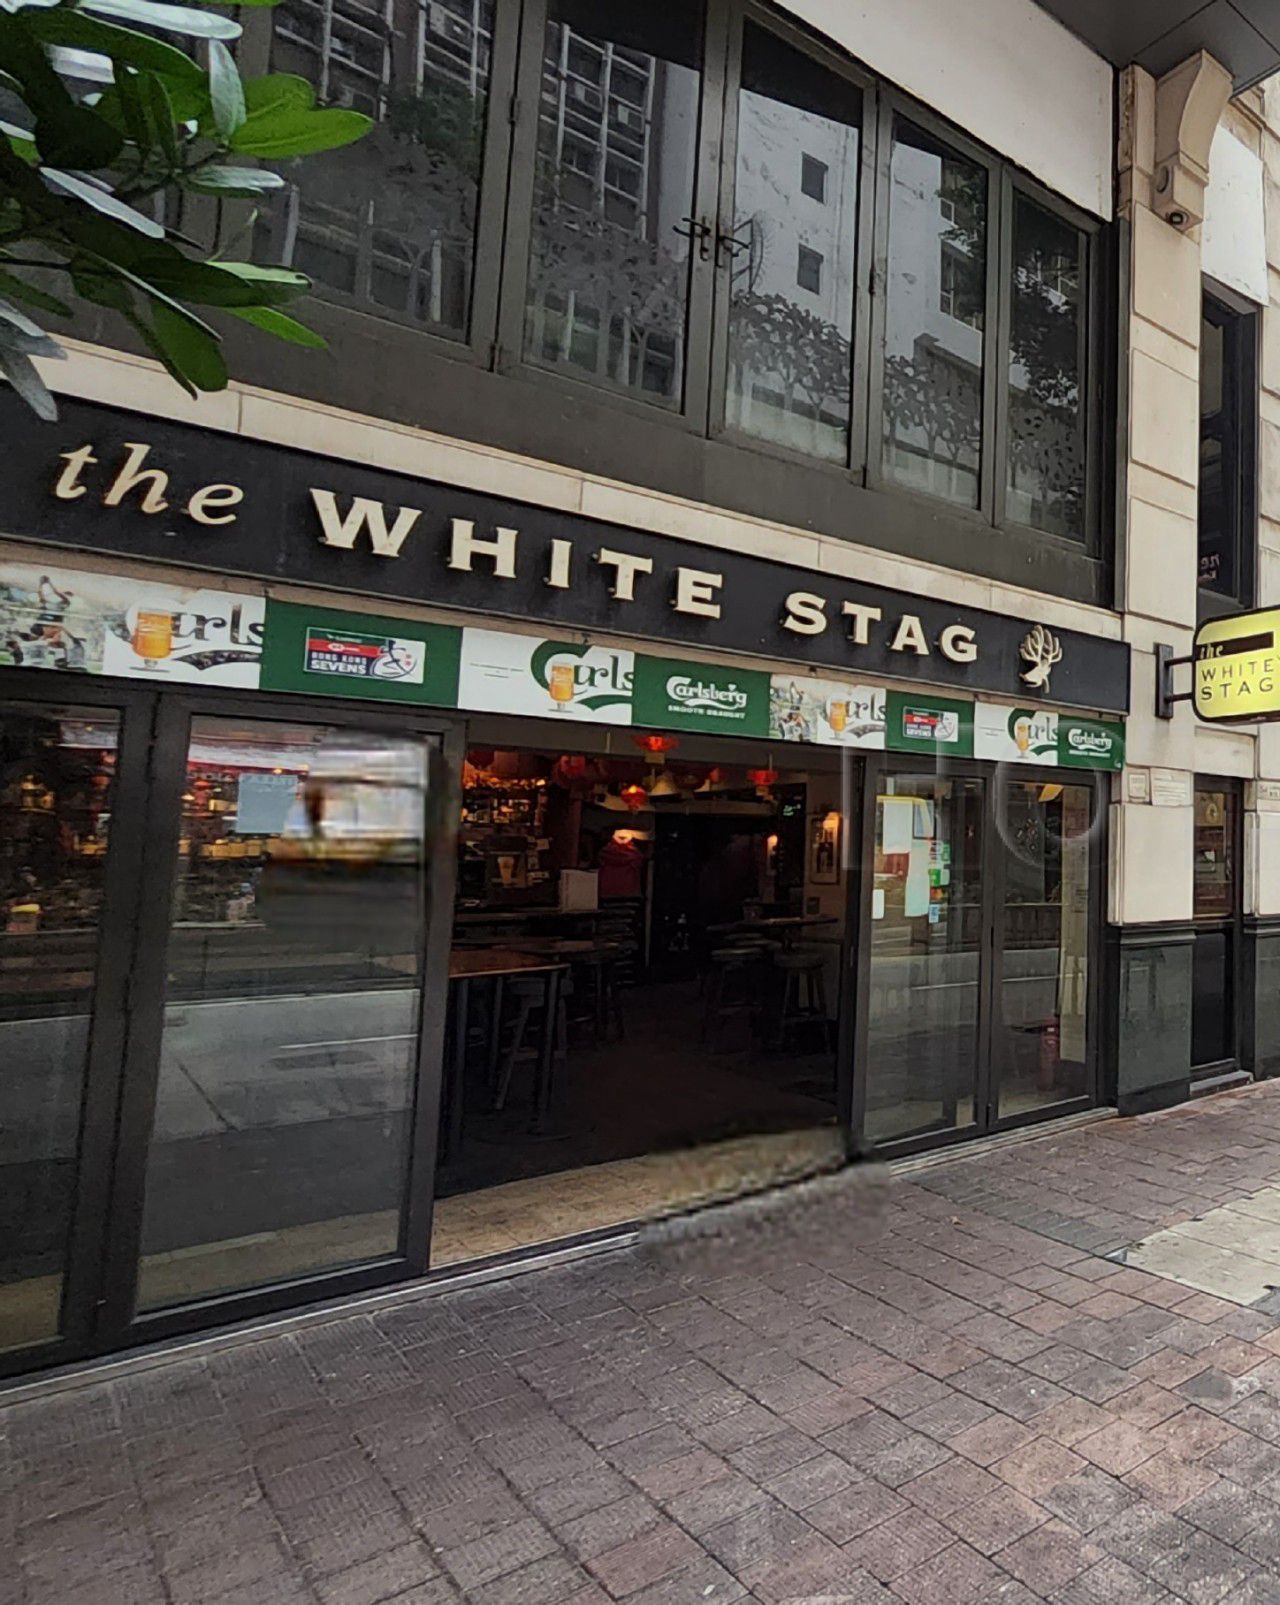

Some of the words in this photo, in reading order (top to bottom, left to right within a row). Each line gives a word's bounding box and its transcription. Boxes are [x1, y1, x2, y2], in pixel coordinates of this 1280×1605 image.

[54, 442, 244, 525] the
[309, 488, 724, 619] WHITE
[782, 590, 979, 664] STAG
[310, 660, 367, 675] SEVENS
[1201, 658, 1275, 682] WHITE
[666, 675, 748, 711] Carlsberg
[1200, 677, 1274, 701] STAG
[1068, 728, 1113, 751] Carlsberg
